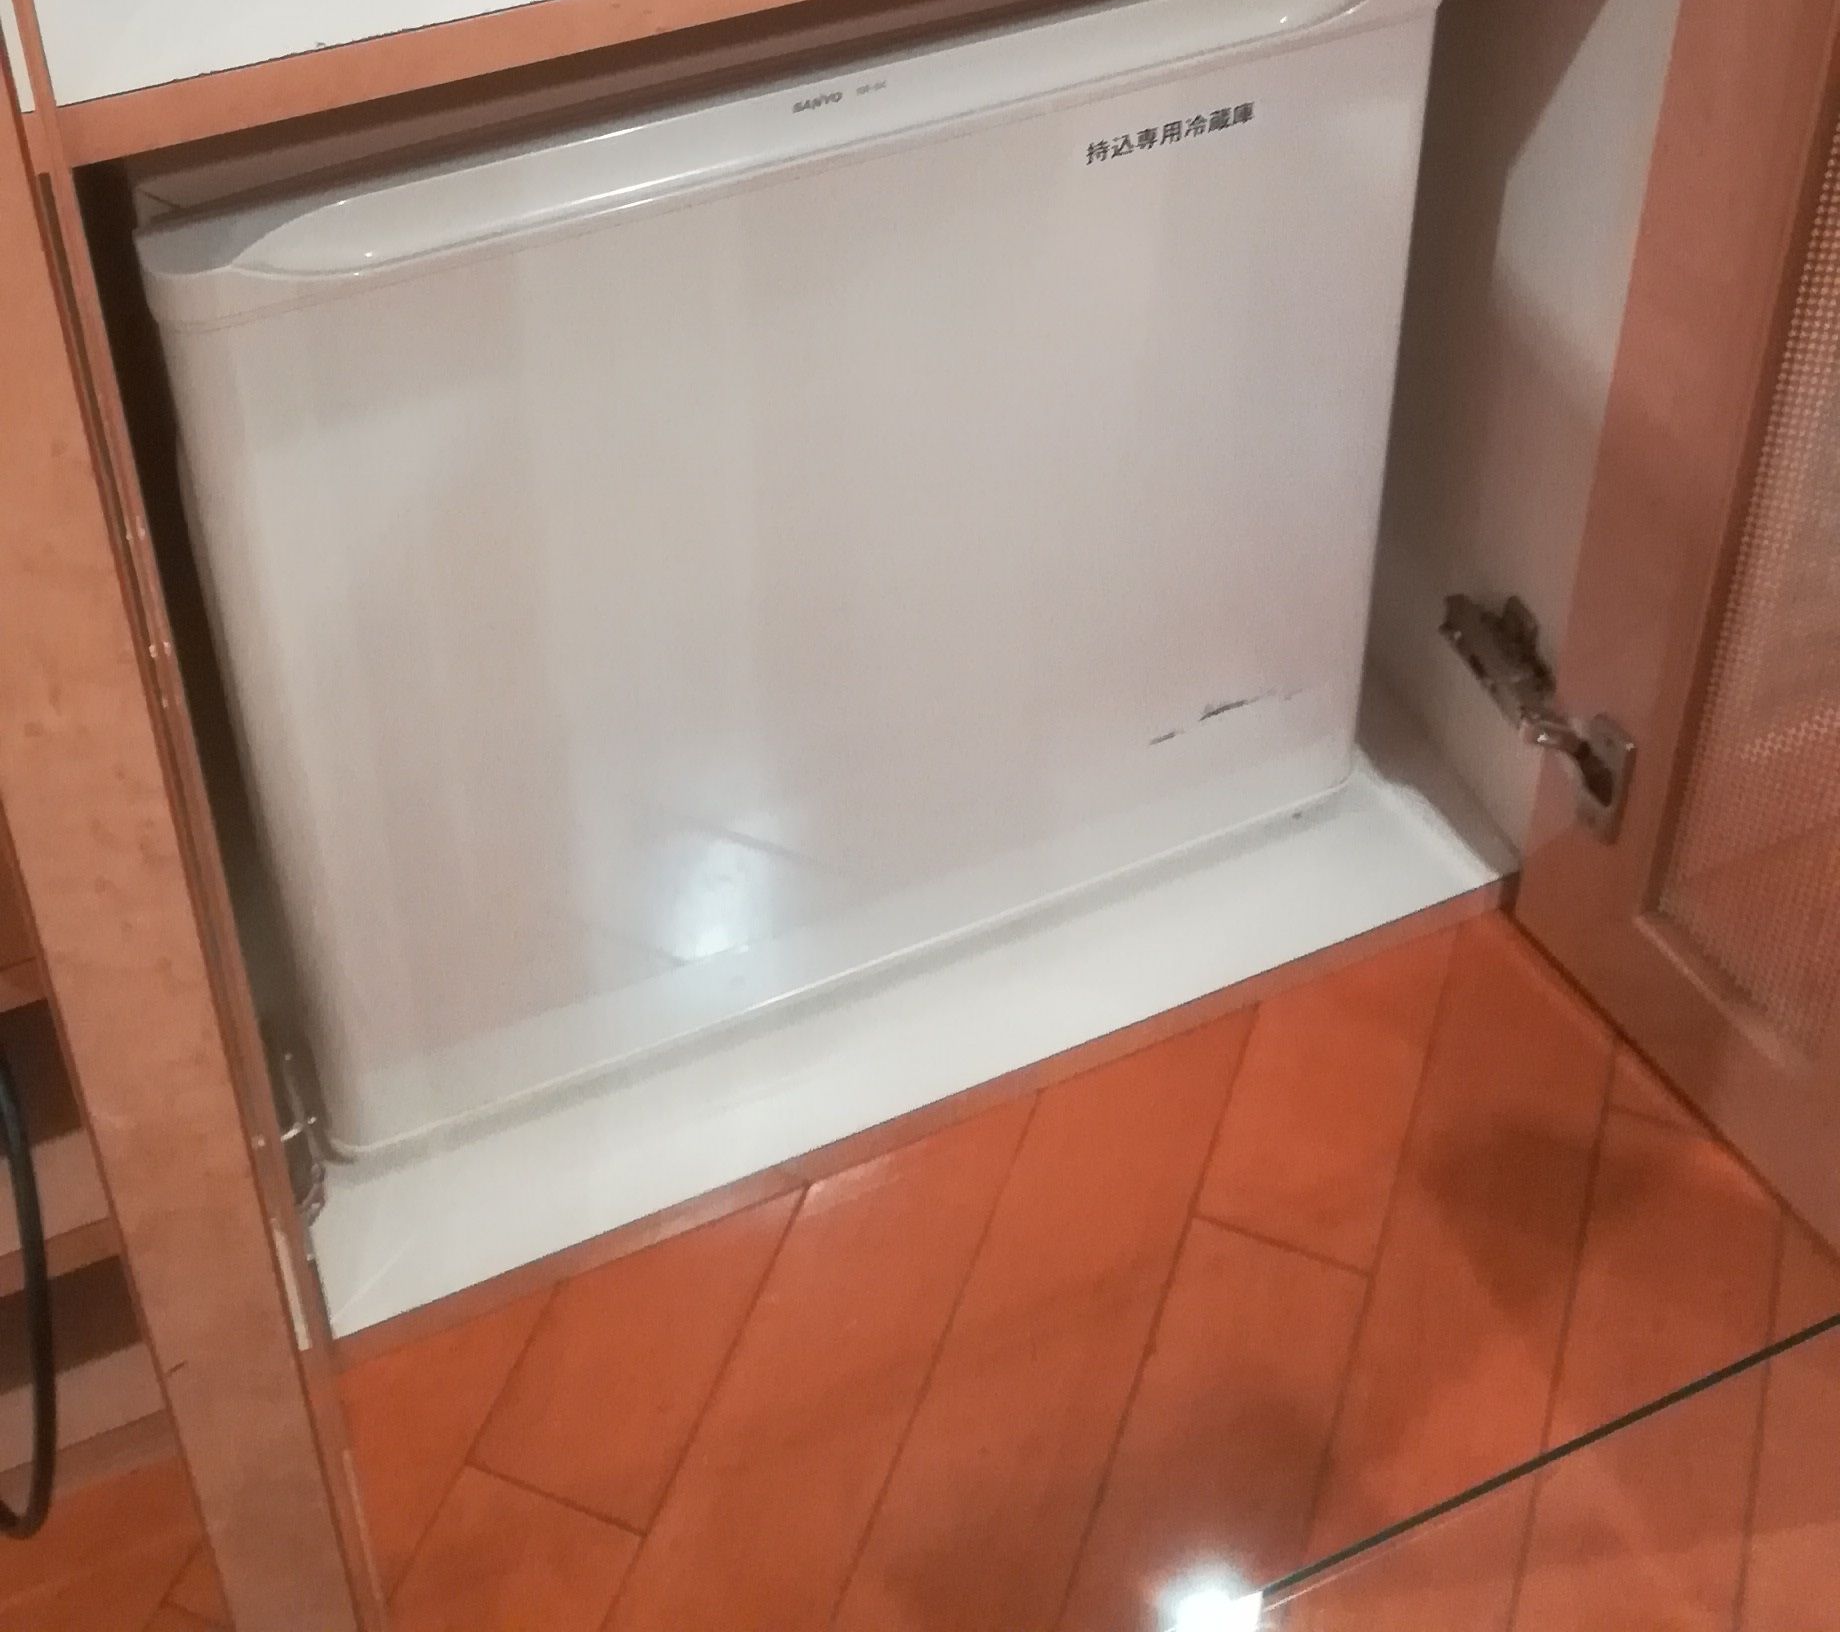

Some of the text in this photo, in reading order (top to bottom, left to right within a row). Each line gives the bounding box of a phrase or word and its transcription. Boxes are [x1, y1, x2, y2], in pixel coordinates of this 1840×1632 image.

[792, 92, 843, 113] SANYO
[1084, 100, 1255, 166] 持込専用冷蔵庫
